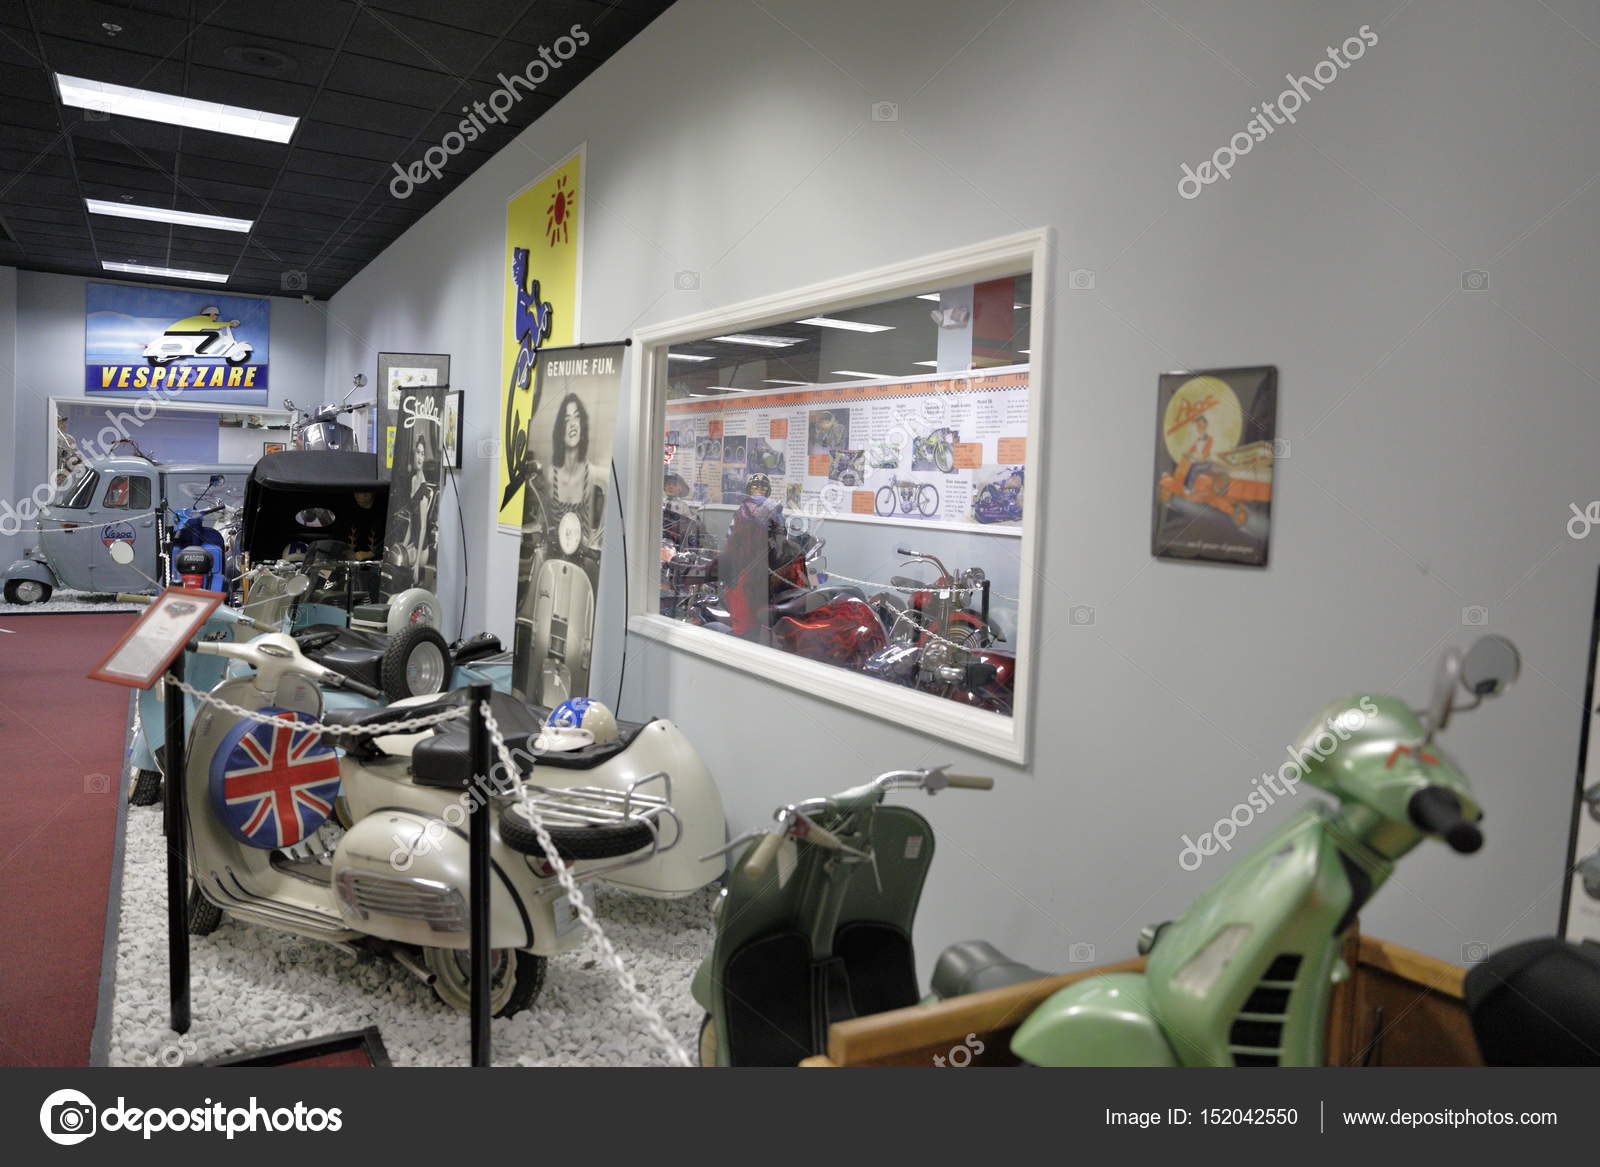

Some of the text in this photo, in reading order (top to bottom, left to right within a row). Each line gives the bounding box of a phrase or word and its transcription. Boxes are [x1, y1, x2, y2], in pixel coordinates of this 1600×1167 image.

[101, 366, 258, 389] VESPIZZARE
[547, 357, 616, 377] GENUINE FUN.
[403, 395, 442, 429] Stella
